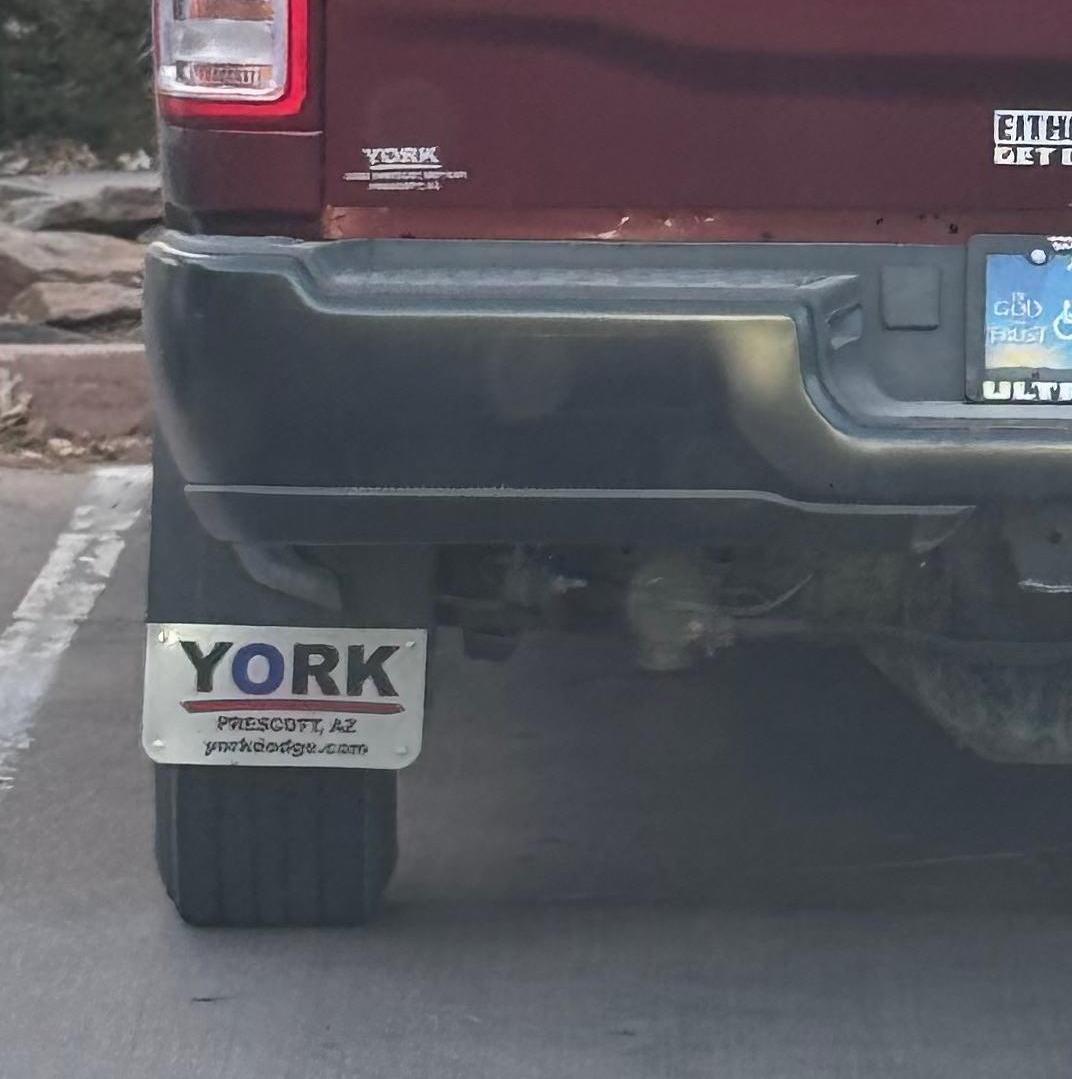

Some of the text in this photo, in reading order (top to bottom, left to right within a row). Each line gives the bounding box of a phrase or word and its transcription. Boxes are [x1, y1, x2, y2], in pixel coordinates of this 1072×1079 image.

[362, 146, 440, 165] YORK
[993, 299, 1043, 319] GOD
[179, 640, 401, 697] YORK
[329, 717, 358, 734] AZ
